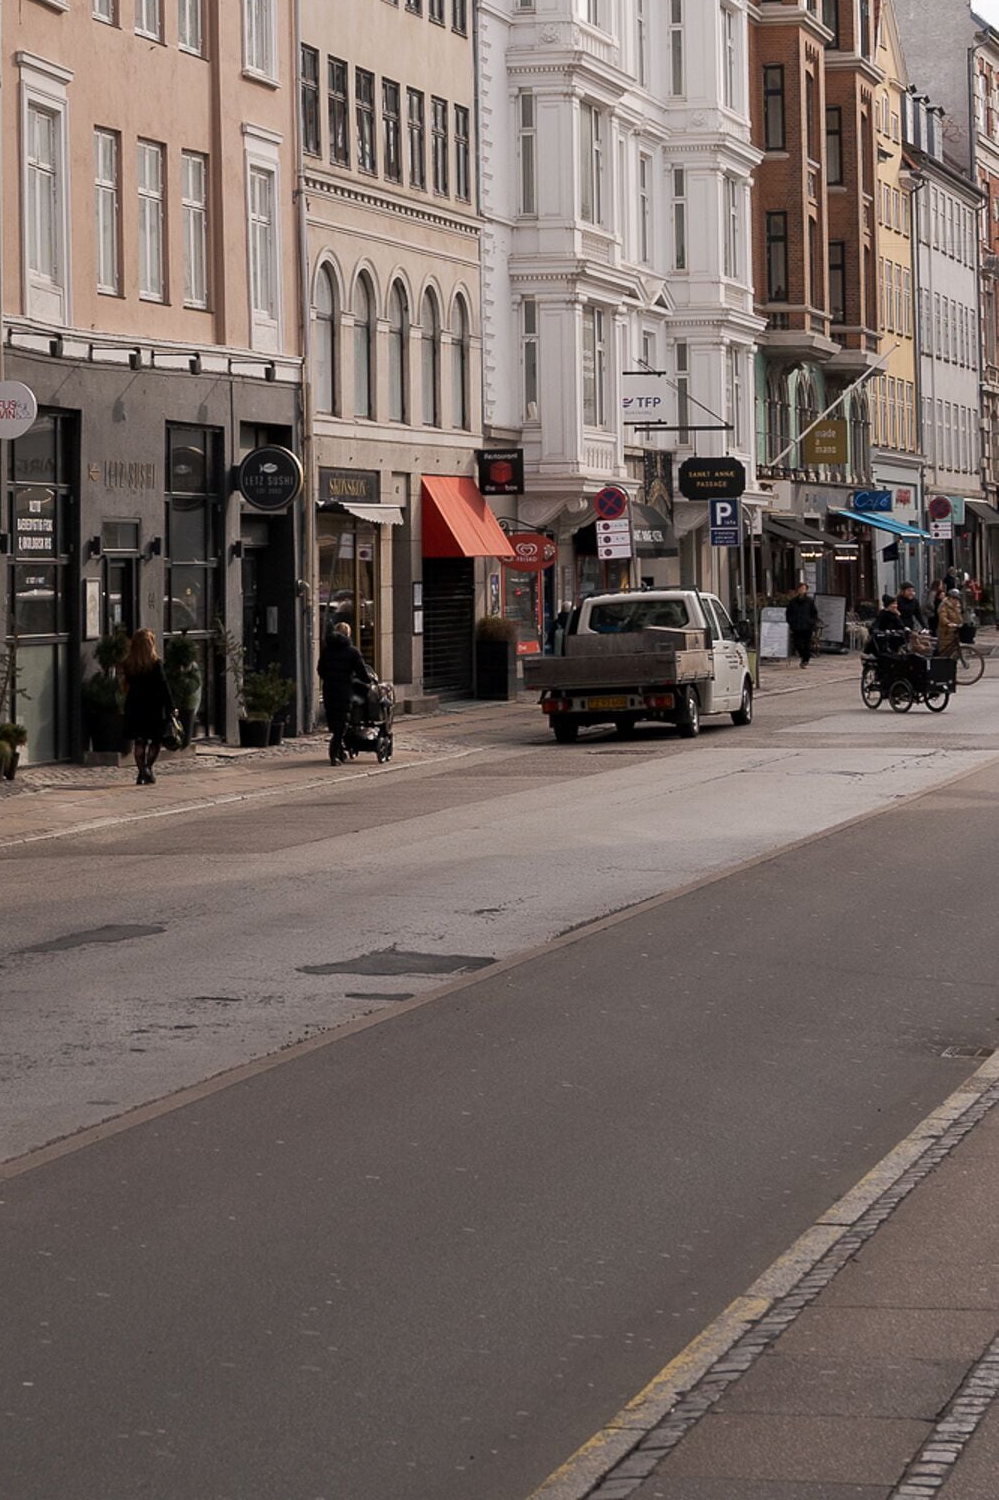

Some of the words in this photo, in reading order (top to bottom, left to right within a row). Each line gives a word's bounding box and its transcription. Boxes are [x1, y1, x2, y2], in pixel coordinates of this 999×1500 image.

[636, 397, 661, 407] TFP
[0, 410, 16, 419] VIN
[104, 460, 125, 489] LETZ
[128, 462, 155, 491] SUSHI
[245, 476, 264, 486] LETZ
[267, 475, 294, 486] SUSHI
[715, 502, 732, 526] P
